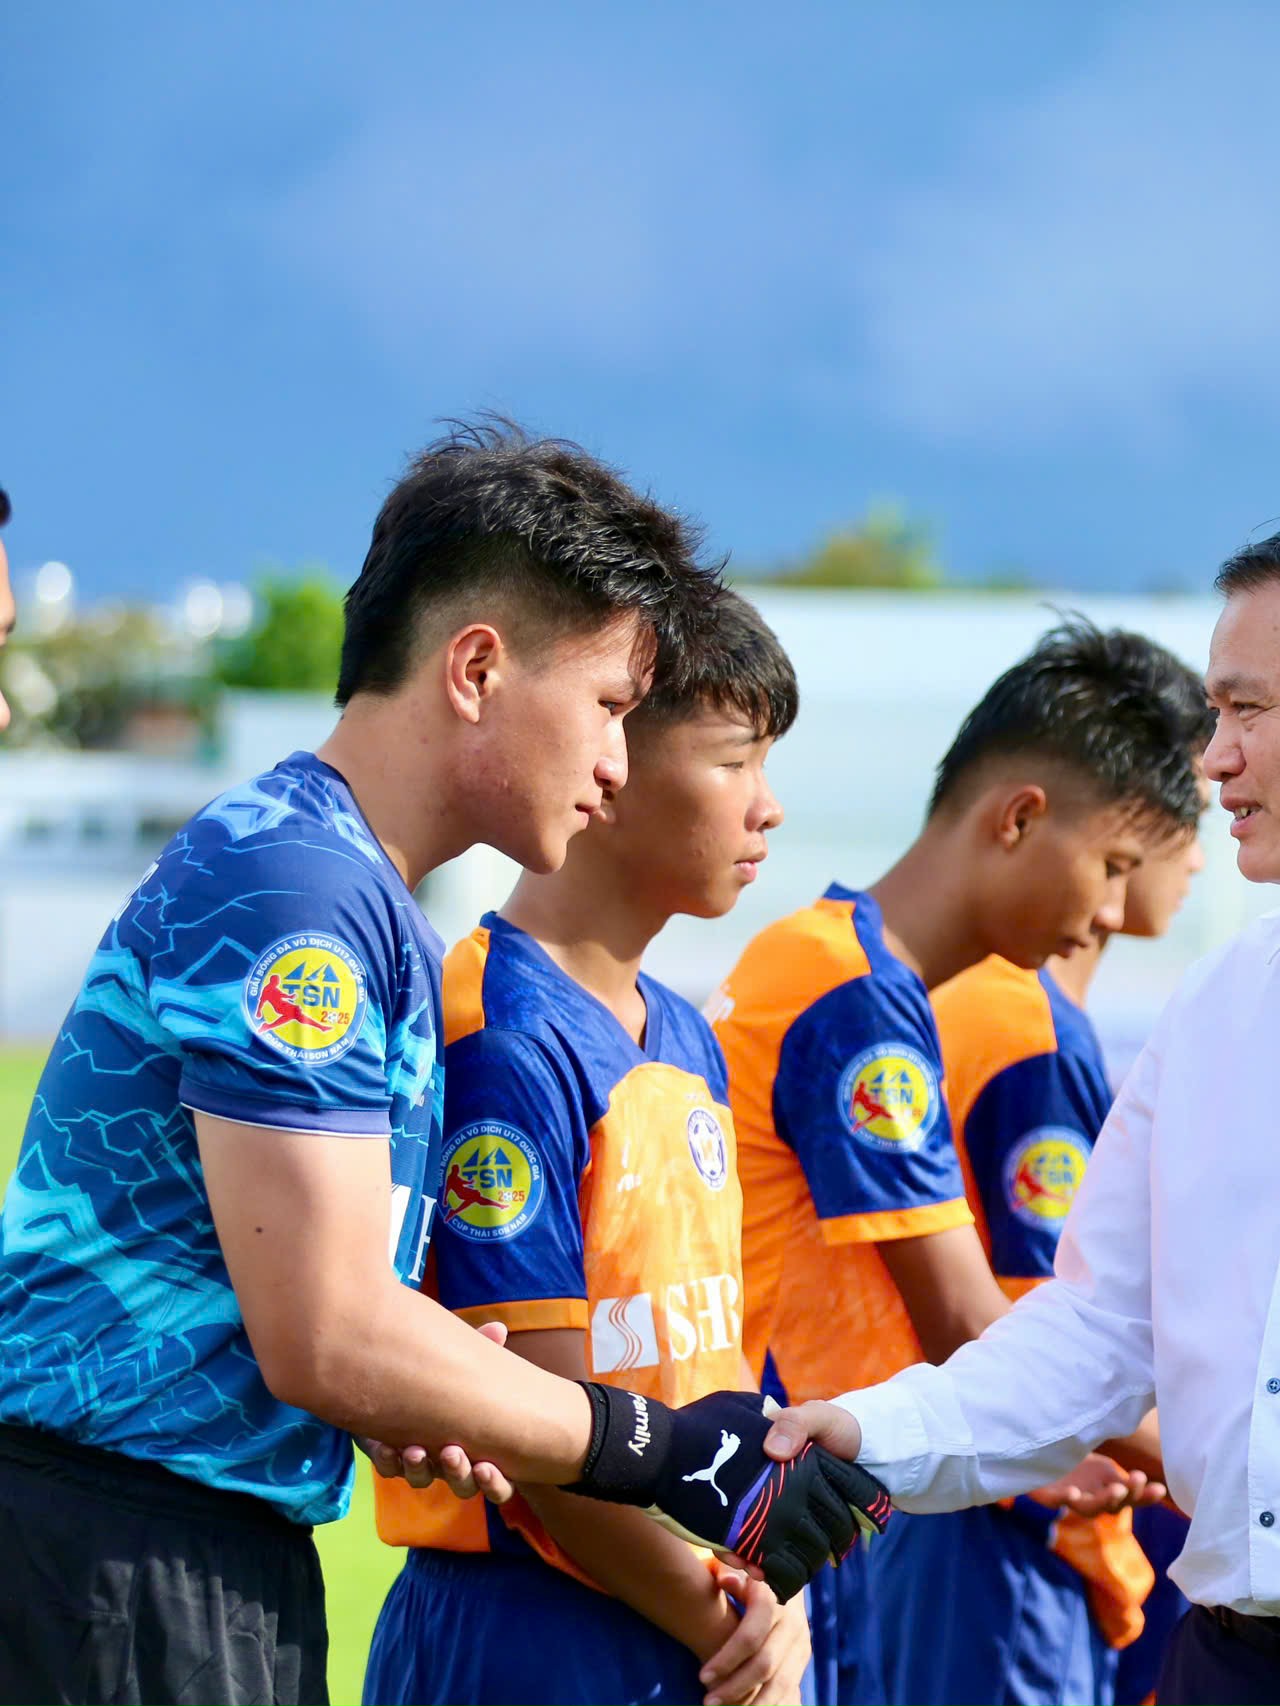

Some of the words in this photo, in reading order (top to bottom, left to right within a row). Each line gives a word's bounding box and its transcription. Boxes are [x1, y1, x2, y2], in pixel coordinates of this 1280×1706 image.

[251, 976, 261, 996] GIẢI
[256, 952, 278, 976] BÓNG
[292, 936, 307, 947] VÔ
[333, 944, 350, 959] U17
[349, 959, 365, 985] QUỐC
[282, 983, 340, 1009] TSN
[285, 1045, 309, 1059] THÁI
[329, 1037, 350, 1055] NAM
[466, 1126, 479, 1136] VÔ
[503, 1129, 520, 1142] U17
[520, 1140, 537, 1164] QUỐC
[532, 1164, 540, 1181] GIA
[462, 1168, 512, 1188] TSN
[510, 1212, 528, 1230] NAM
[666, 1274, 741, 1363] SHB
